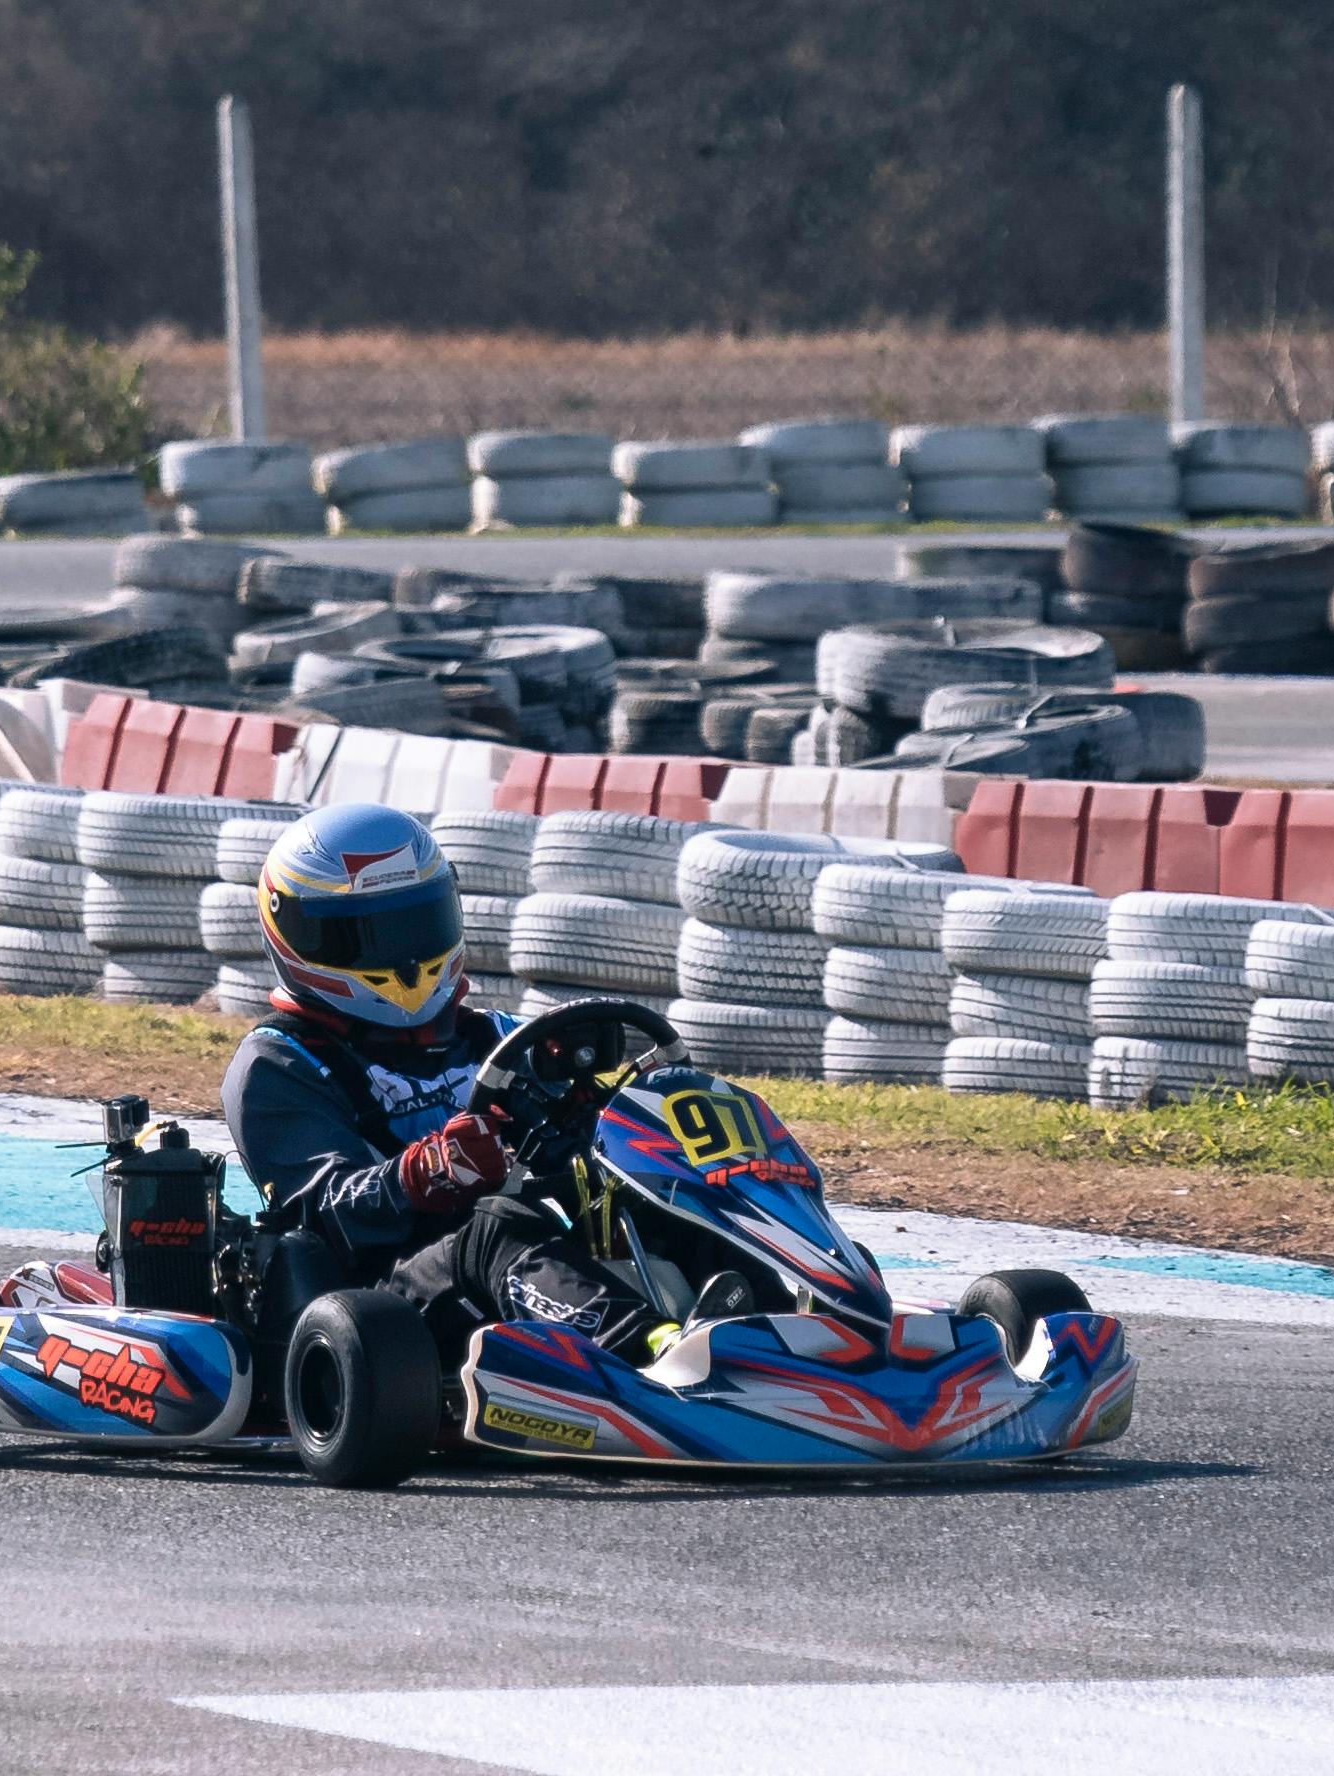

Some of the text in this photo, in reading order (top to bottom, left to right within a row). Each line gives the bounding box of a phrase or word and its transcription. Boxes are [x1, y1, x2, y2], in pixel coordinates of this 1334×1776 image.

[671, 1094, 757, 1159] 97
[80, 1378, 156, 1424] RACING
[490, 1407, 591, 1441] NOGOYA
